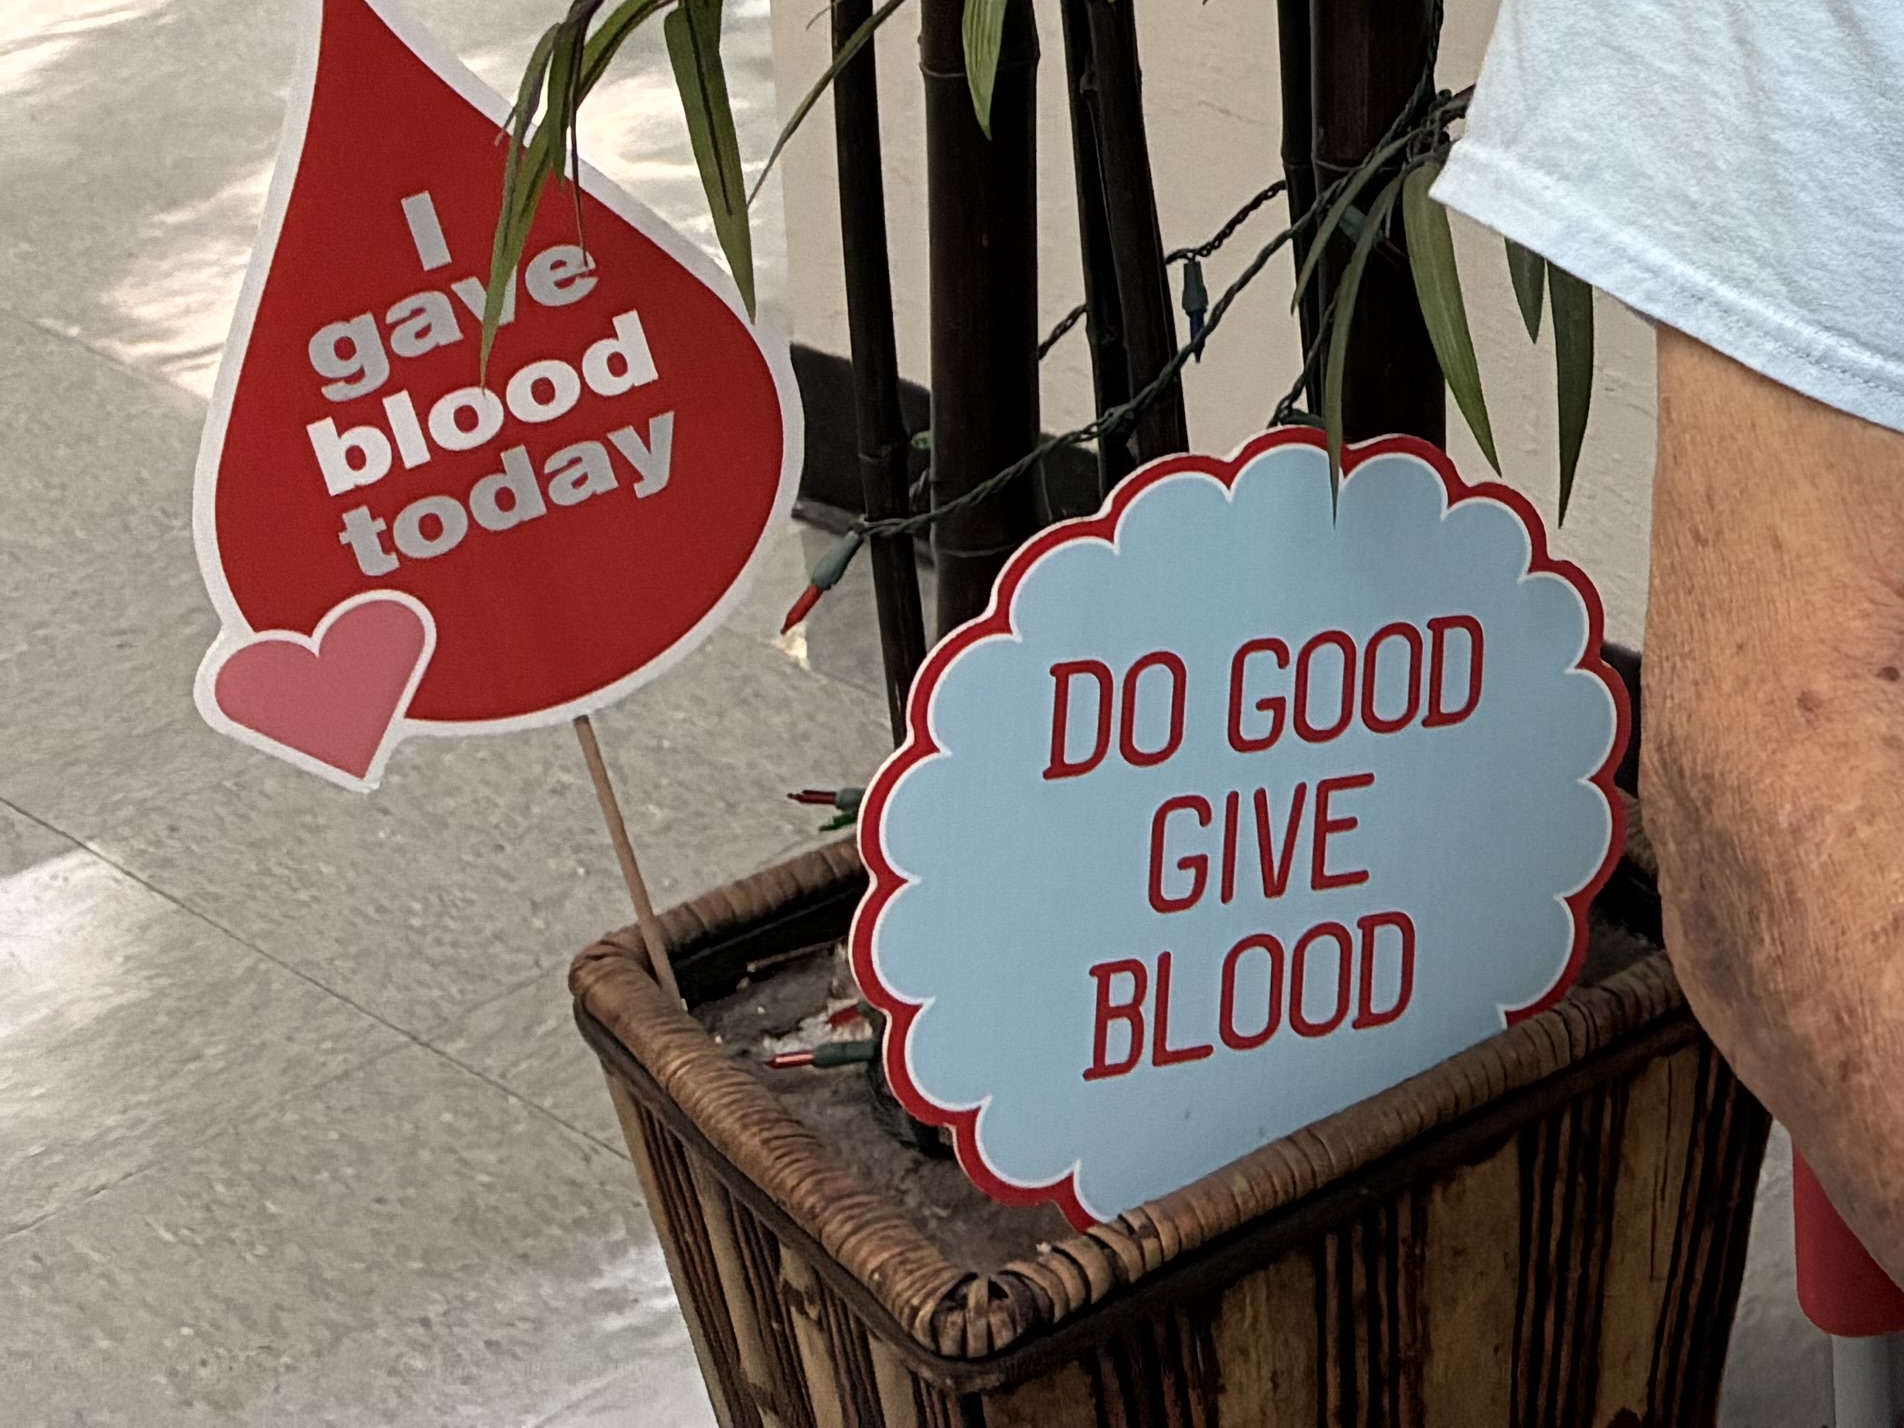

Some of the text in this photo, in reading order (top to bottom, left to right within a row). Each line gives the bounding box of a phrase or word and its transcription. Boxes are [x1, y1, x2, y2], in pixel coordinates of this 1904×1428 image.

[401, 190, 452, 272] I
[305, 308, 660, 497] blood
[338, 409, 677, 578] today
[1041, 614, 1485, 781] DO GOOD
[1147, 772, 1376, 915] GIVE
[1082, 910, 1416, 1082] BLOOD
